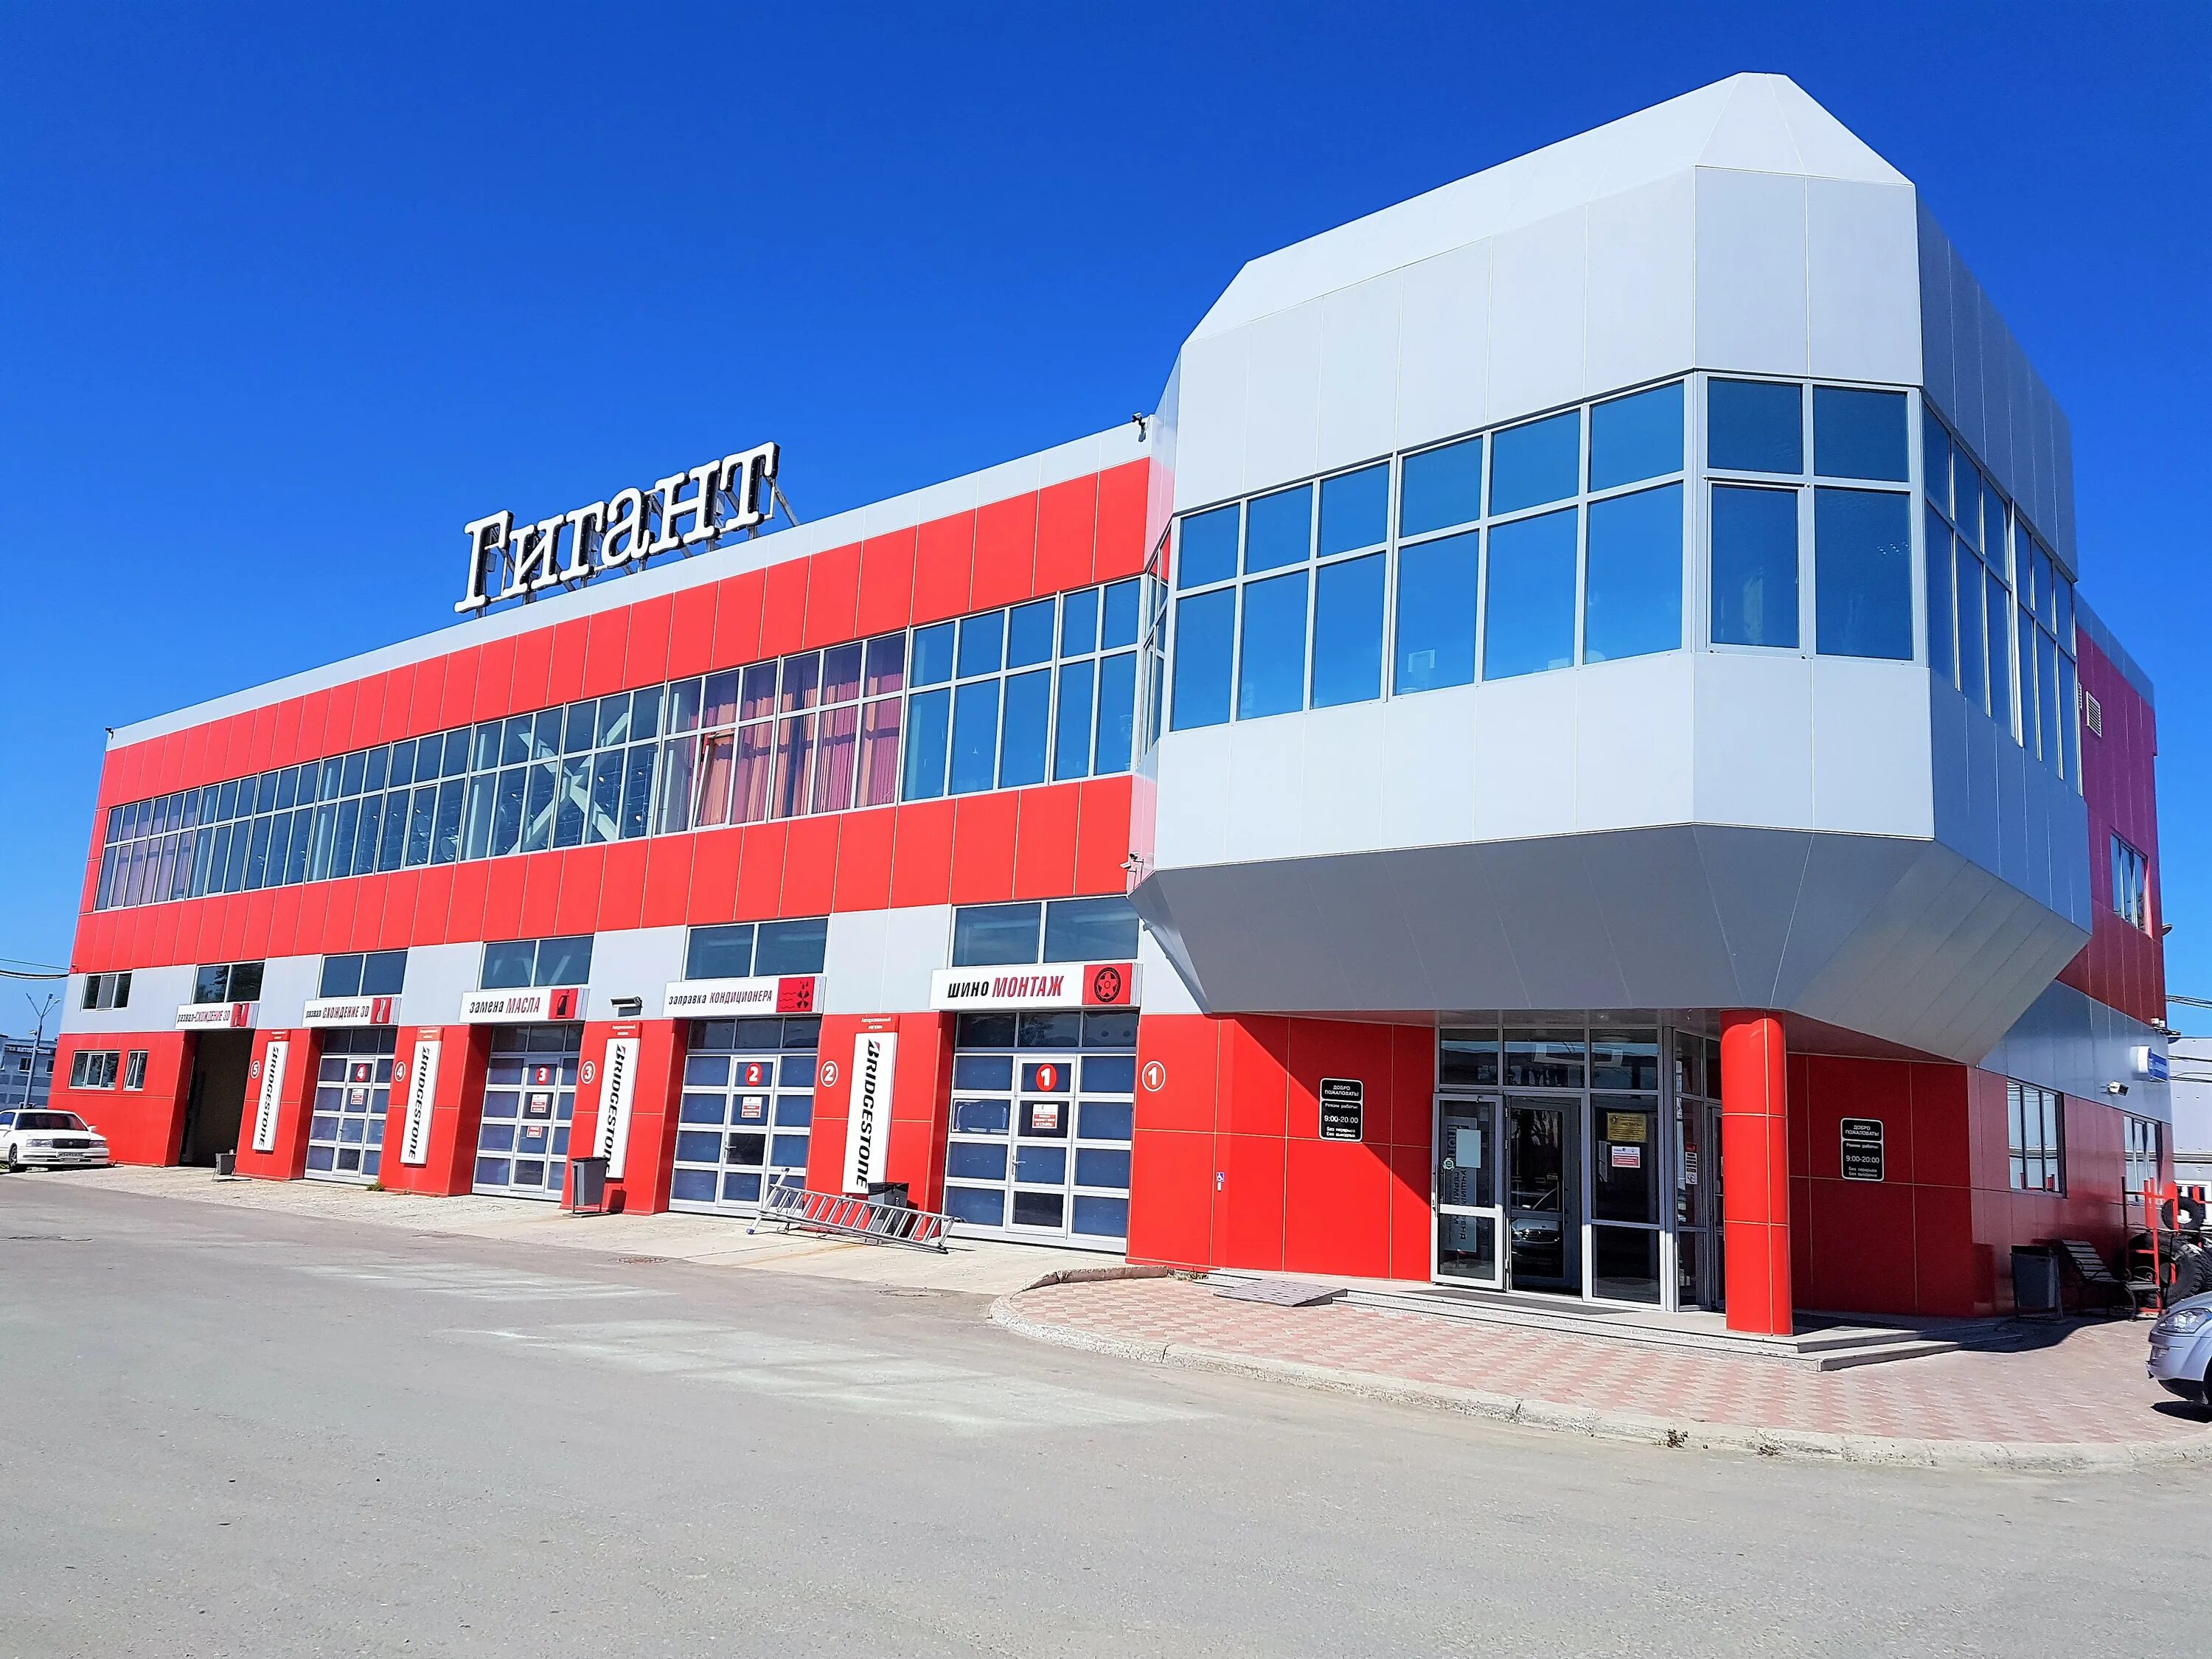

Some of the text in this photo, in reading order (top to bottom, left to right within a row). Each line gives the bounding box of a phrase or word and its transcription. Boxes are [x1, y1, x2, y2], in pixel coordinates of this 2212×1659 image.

[453, 441, 780, 613] Гигант
[992, 975, 1064, 998] МОНТАЖ
[470, 997, 540, 1014] замена МАСЛА
[669, 990, 773, 1006] заправка КОНДИЦИОНЕРА
[322, 1006, 360, 1020] СХОЖДЕНИЕ
[538, 1067, 547, 1082] 3
[748, 1065, 759, 1082] 2
[824, 1065, 835, 1082] 2
[1040, 1068, 1051, 1086] 1
[1147, 1066, 1158, 1085] 1
[259, 1046, 279, 1147] BRIDGESTONE
[408, 1046, 430, 1160] BRIDGESTONE
[856, 1038, 880, 1189] BRIDGESTONE
[1324, 1115, 1358, 1124] 9:00-20:00
[1846, 1155, 1879, 1164] 9:00-20:00
